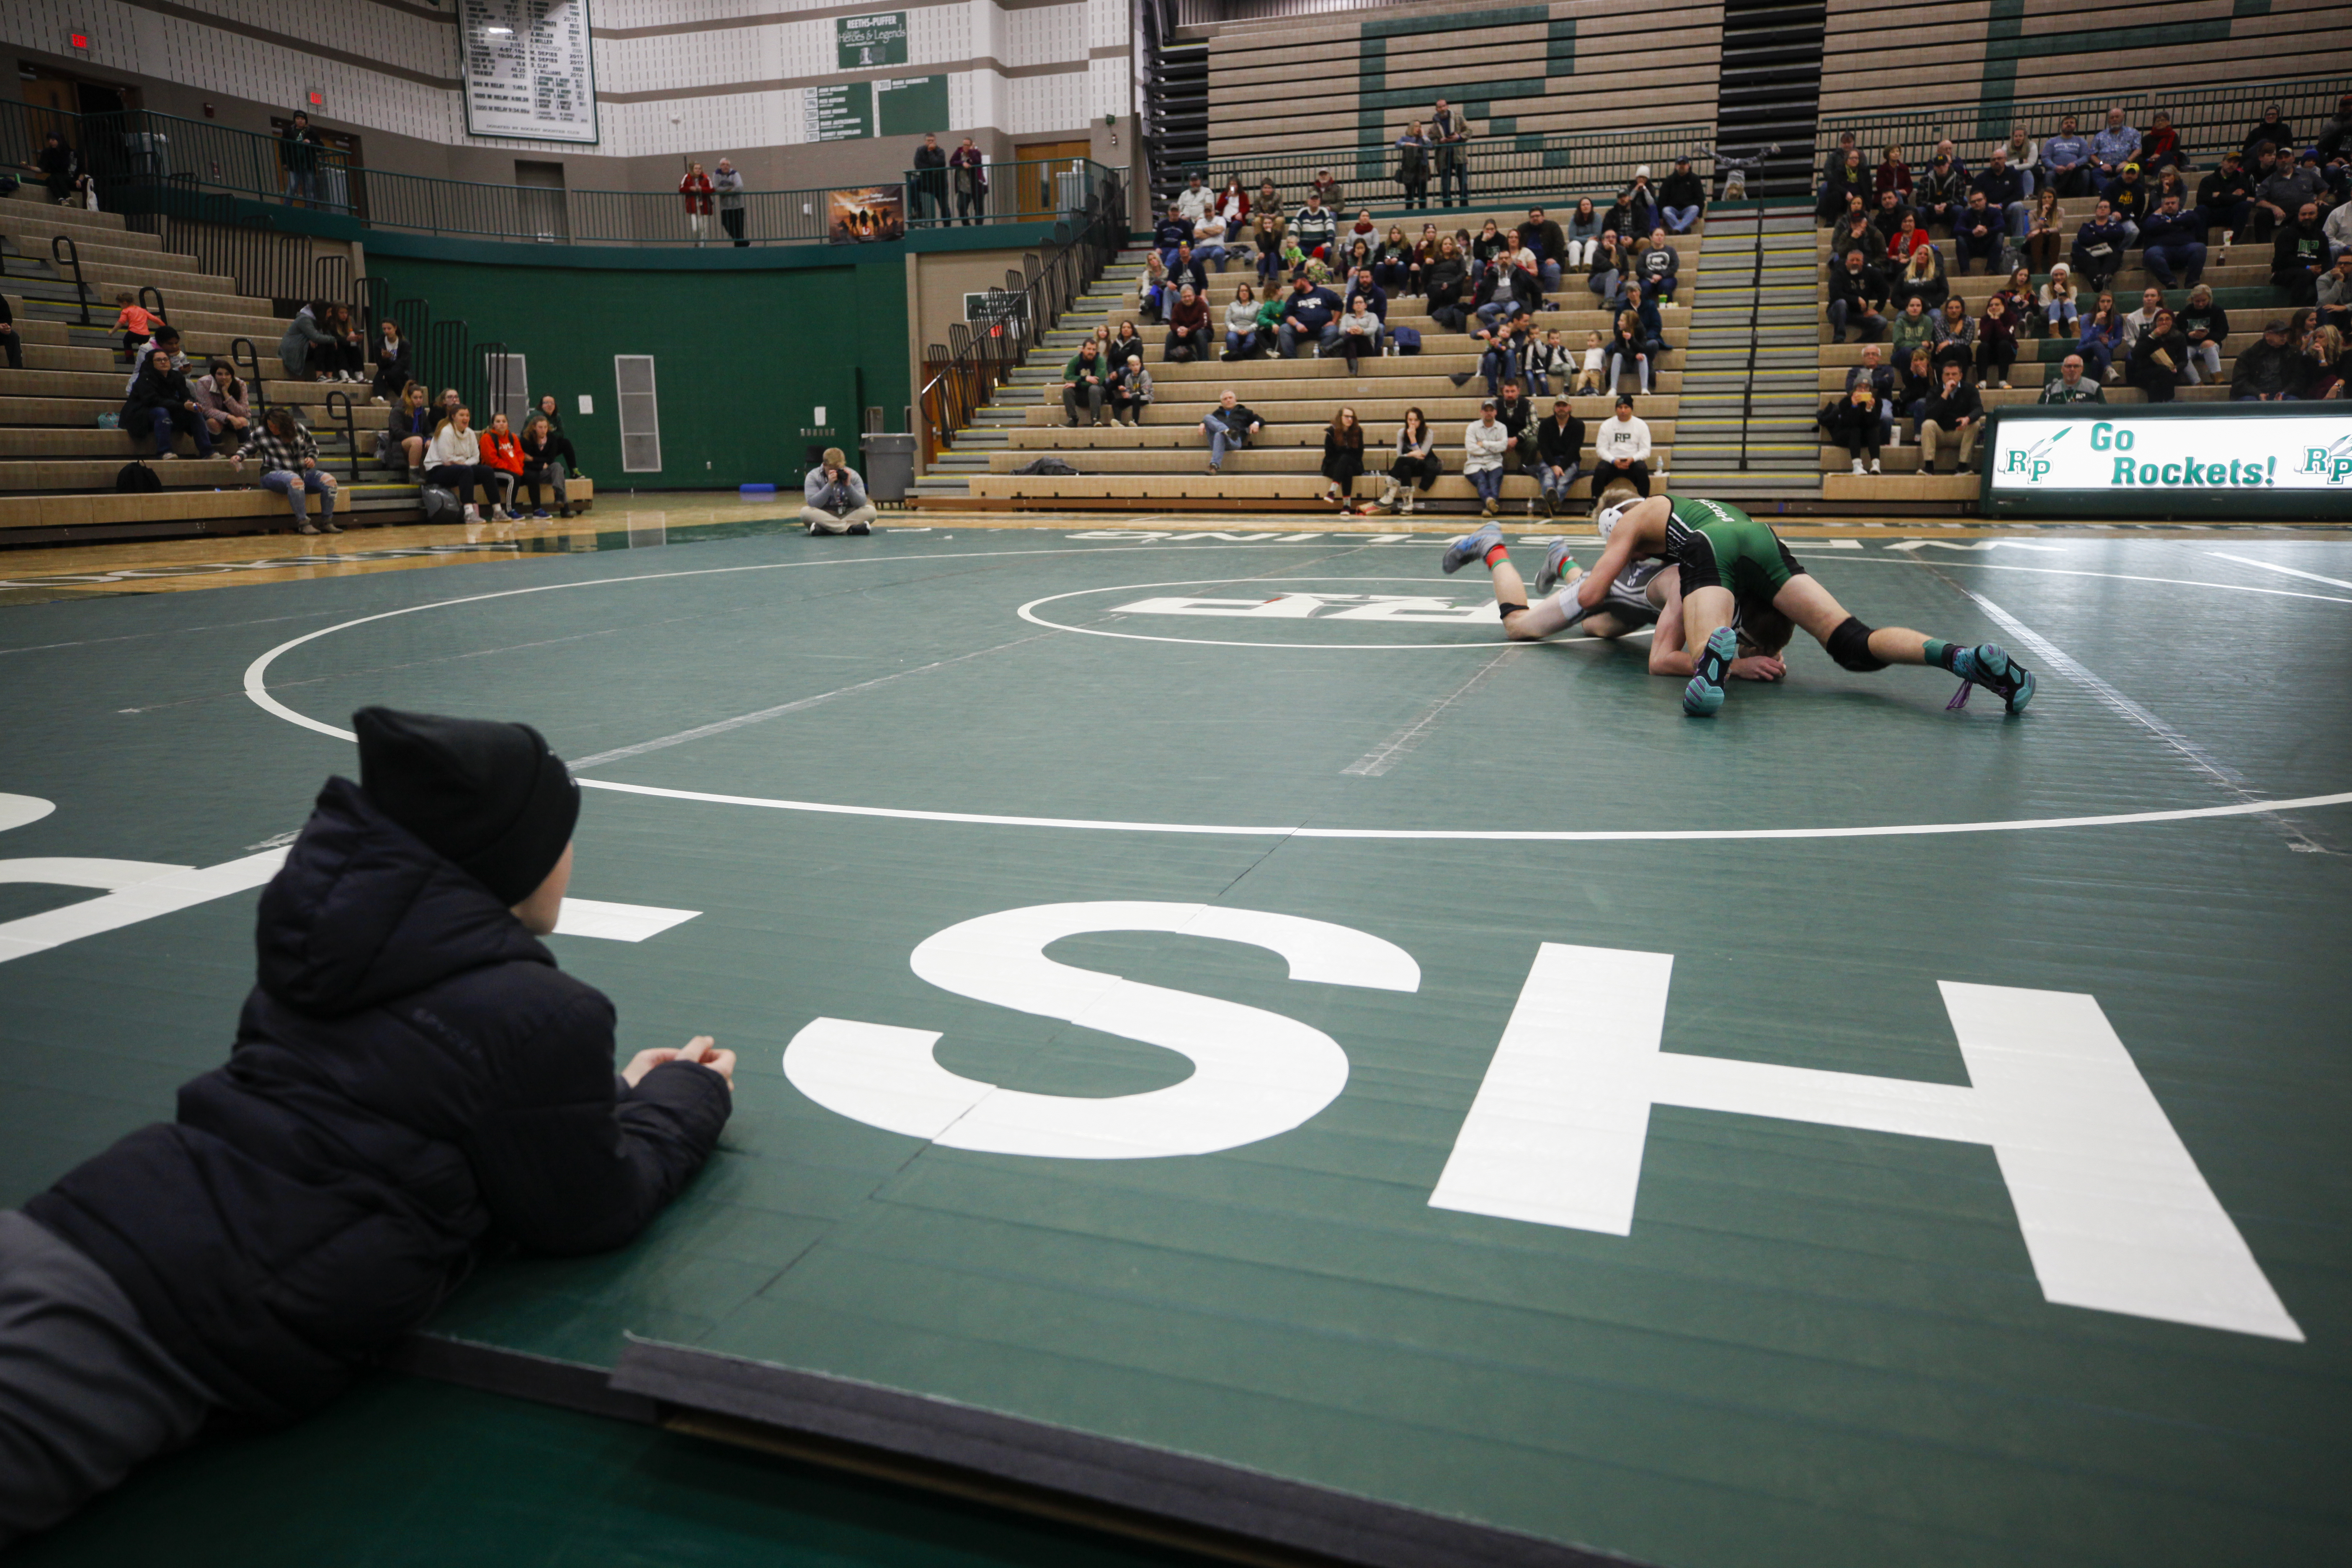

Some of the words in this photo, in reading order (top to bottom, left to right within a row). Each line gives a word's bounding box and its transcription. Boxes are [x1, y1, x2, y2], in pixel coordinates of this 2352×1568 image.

[838, 32, 865, 43] Heroes
[874, 23, 906, 44] Legends
[846, 15, 897, 29] REETHS-PUFFER
[1614, 433, 1631, 443] RP
[2090, 422, 2135, 451] Go
[2005, 447, 2053, 485] RP
[2111, 455, 2277, 487] Rockets!
